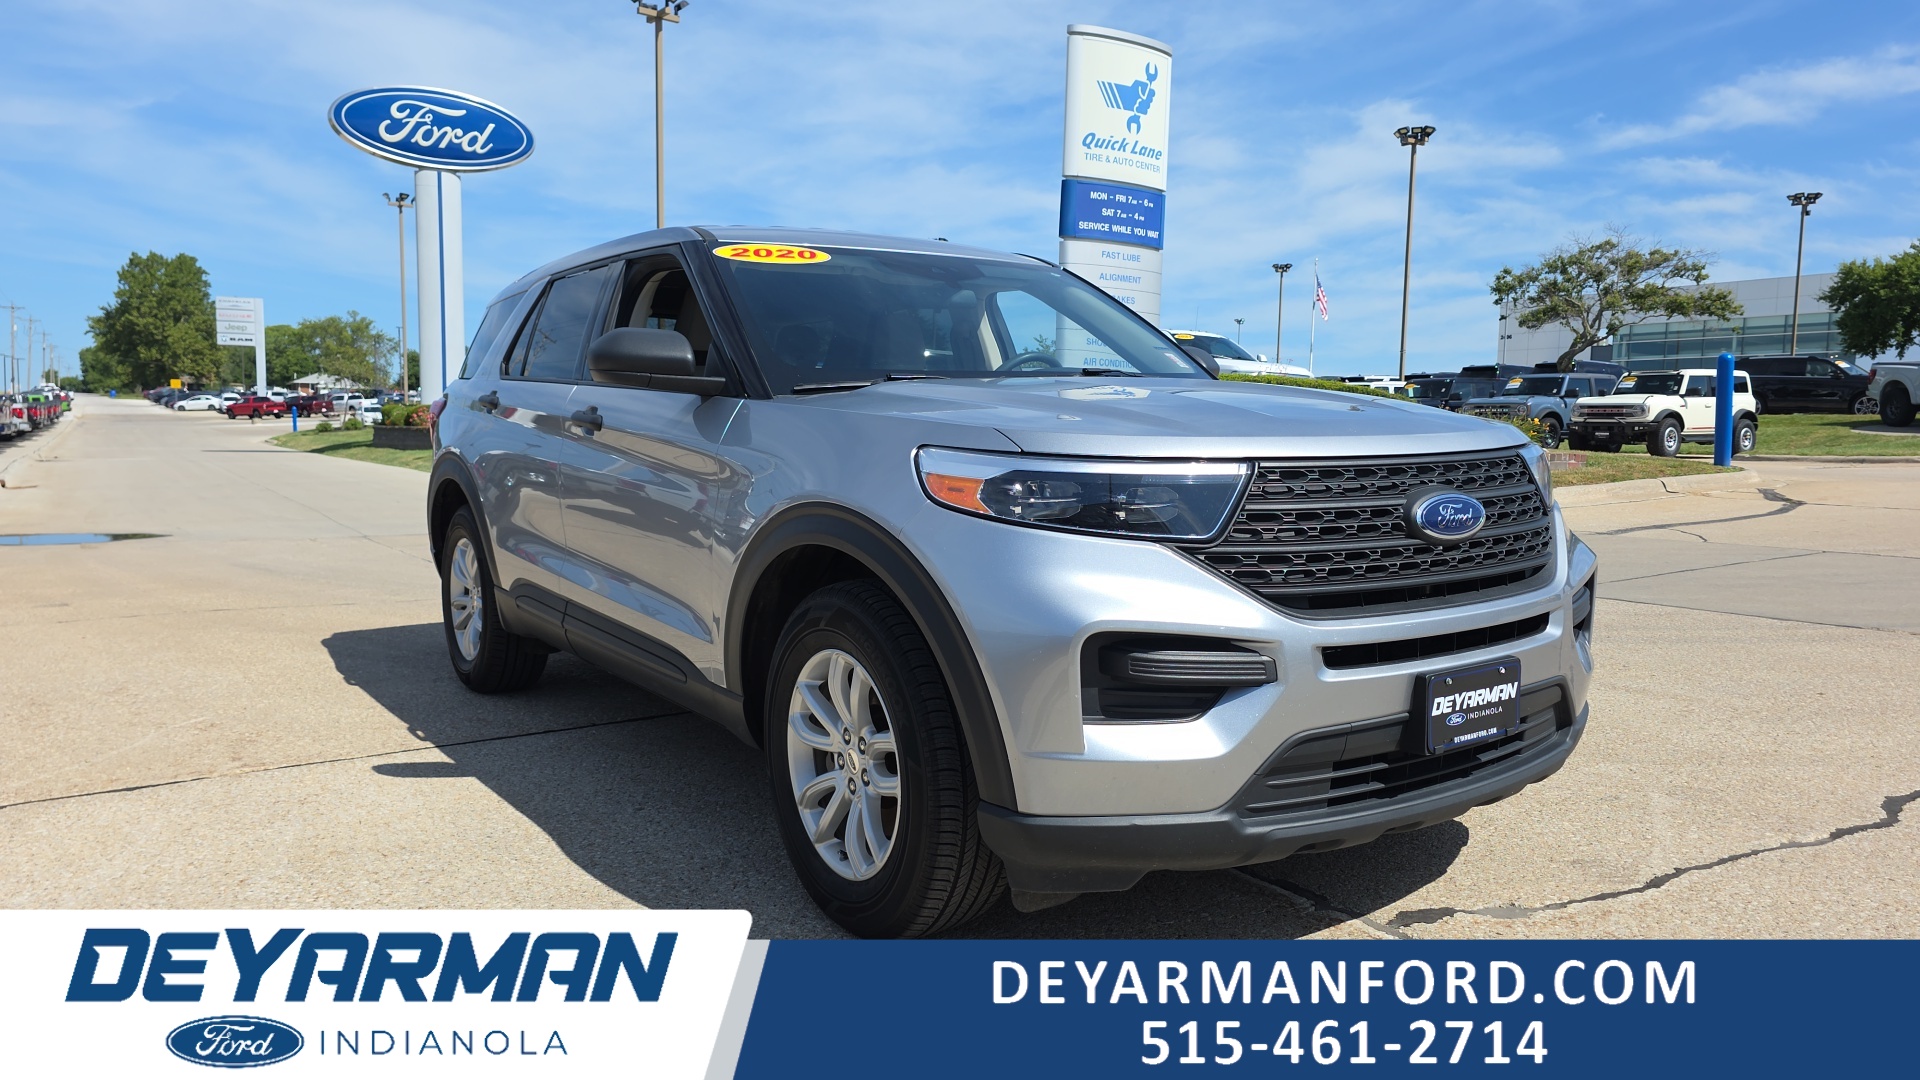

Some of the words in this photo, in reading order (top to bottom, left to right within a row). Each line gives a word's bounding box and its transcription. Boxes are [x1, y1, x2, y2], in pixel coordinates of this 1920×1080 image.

[378, 99, 495, 154] Ford
[1082, 132, 1130, 152] Quick
[1130, 140, 1163, 160] Lane
[1084, 152, 1103, 162] TIRE
[1105, 155, 1111, 163] &
[1112, 156, 1134, 167] AUTO
[1135, 161, 1161, 174] CENTER
[1090, 191, 1107, 200] MON
[1115, 194, 1126, 203] FRI
[1101, 208, 1115, 217] SAT
[1079, 221, 1109, 232] SERVICE
[1111, 224, 1132, 234] WHILE
[1133, 227, 1146, 236] YOU
[1147, 229, 1160, 239] WAIT
[730, 248, 817, 259] 2020
[1101, 250, 1121, 260] FAST
[1122, 253, 1141, 262] LUBE
[1099, 272, 1141, 284] ALIGNMENT
[1112, 294, 1135, 305] AKES
[224, 323, 248, 332] Jeep
[1083, 357, 1097, 366] AIR
[1437, 503, 1474, 529] Ford
[1431, 681, 1519, 717] DEYARMAN
[1467, 705, 1503, 720] INDIANOLA
